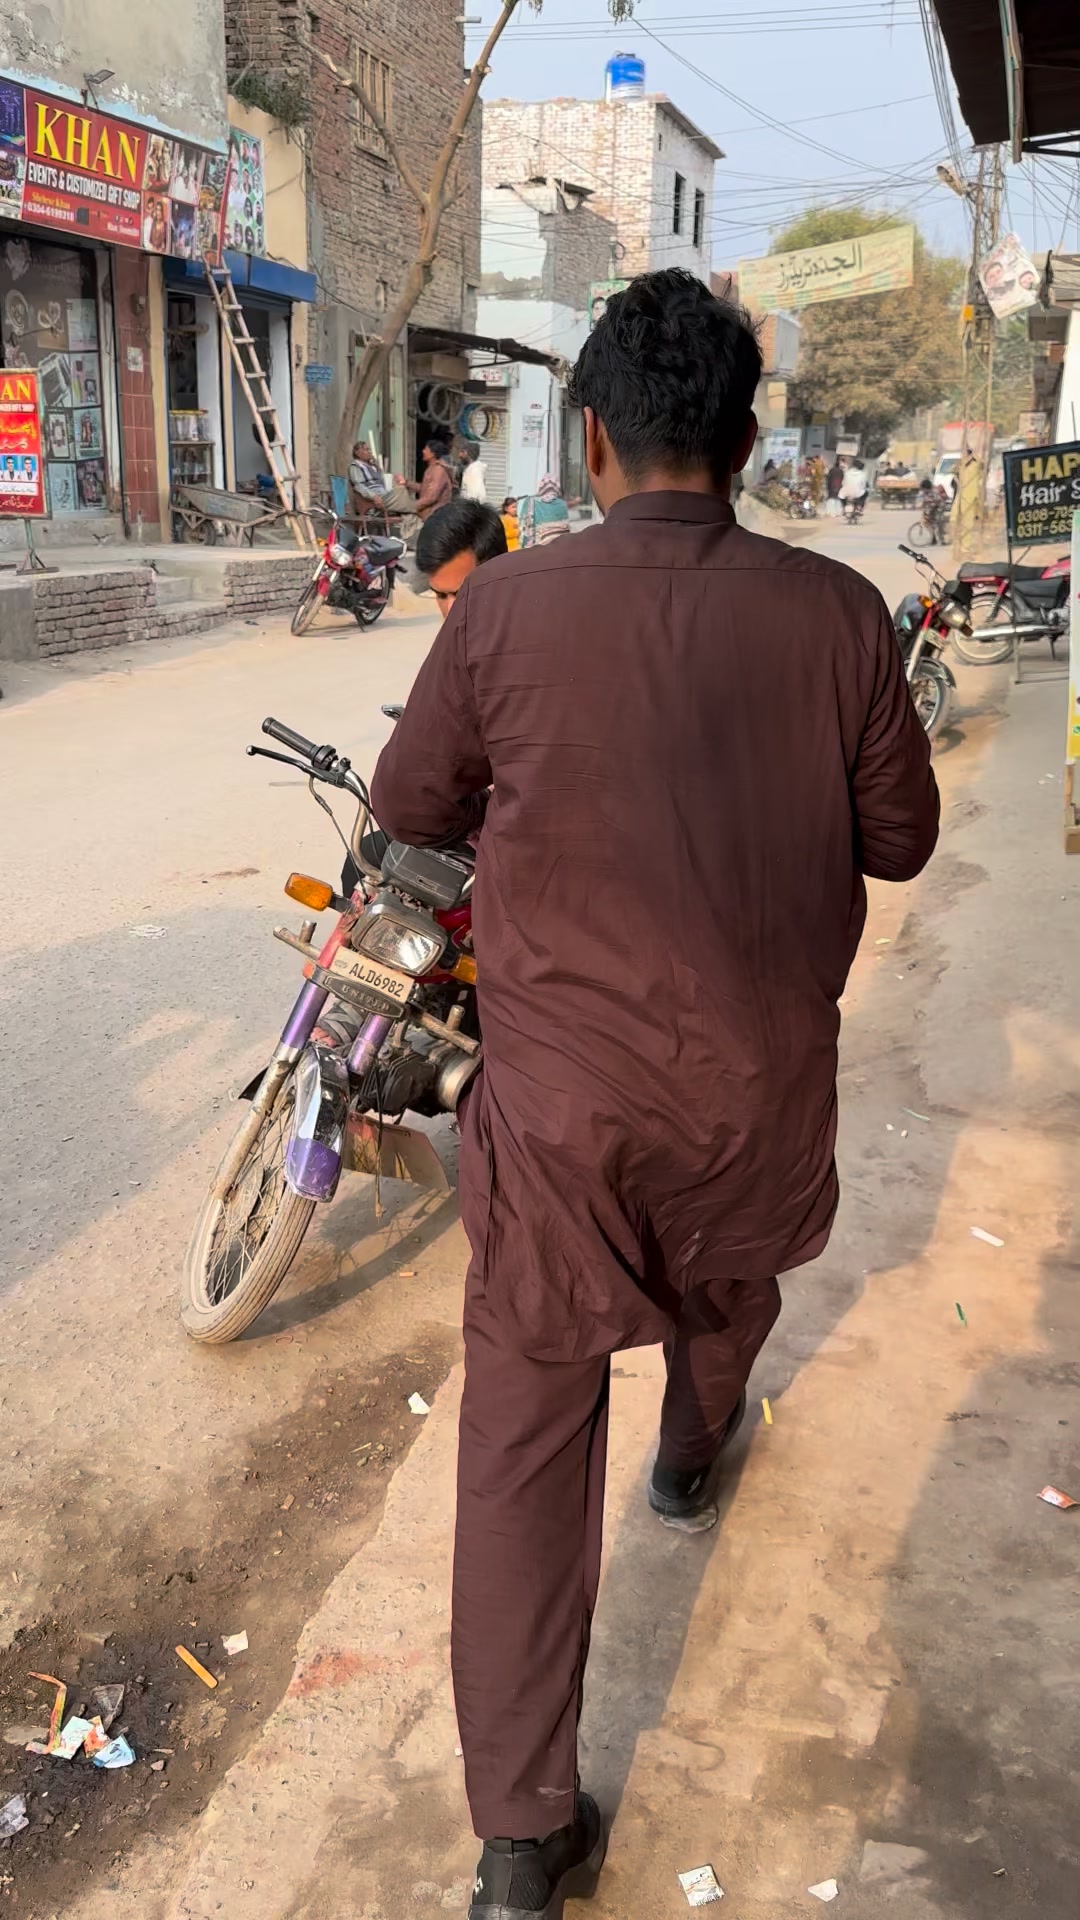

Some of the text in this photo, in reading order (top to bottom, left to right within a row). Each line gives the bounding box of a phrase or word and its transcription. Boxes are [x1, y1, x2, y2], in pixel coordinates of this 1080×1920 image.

[33, 101, 141, 184] KHAN
[58, 170, 66, 191] &
[66, 173, 107, 202] CUSTOMIZED
[108, 184, 123, 206] GIFT
[123, 189, 141, 211] SHOP
[1021, 452, 1080, 483] HAP
[1019, 482, 1066, 508] Hair
[349, 962, 404, 998] ALD6982
